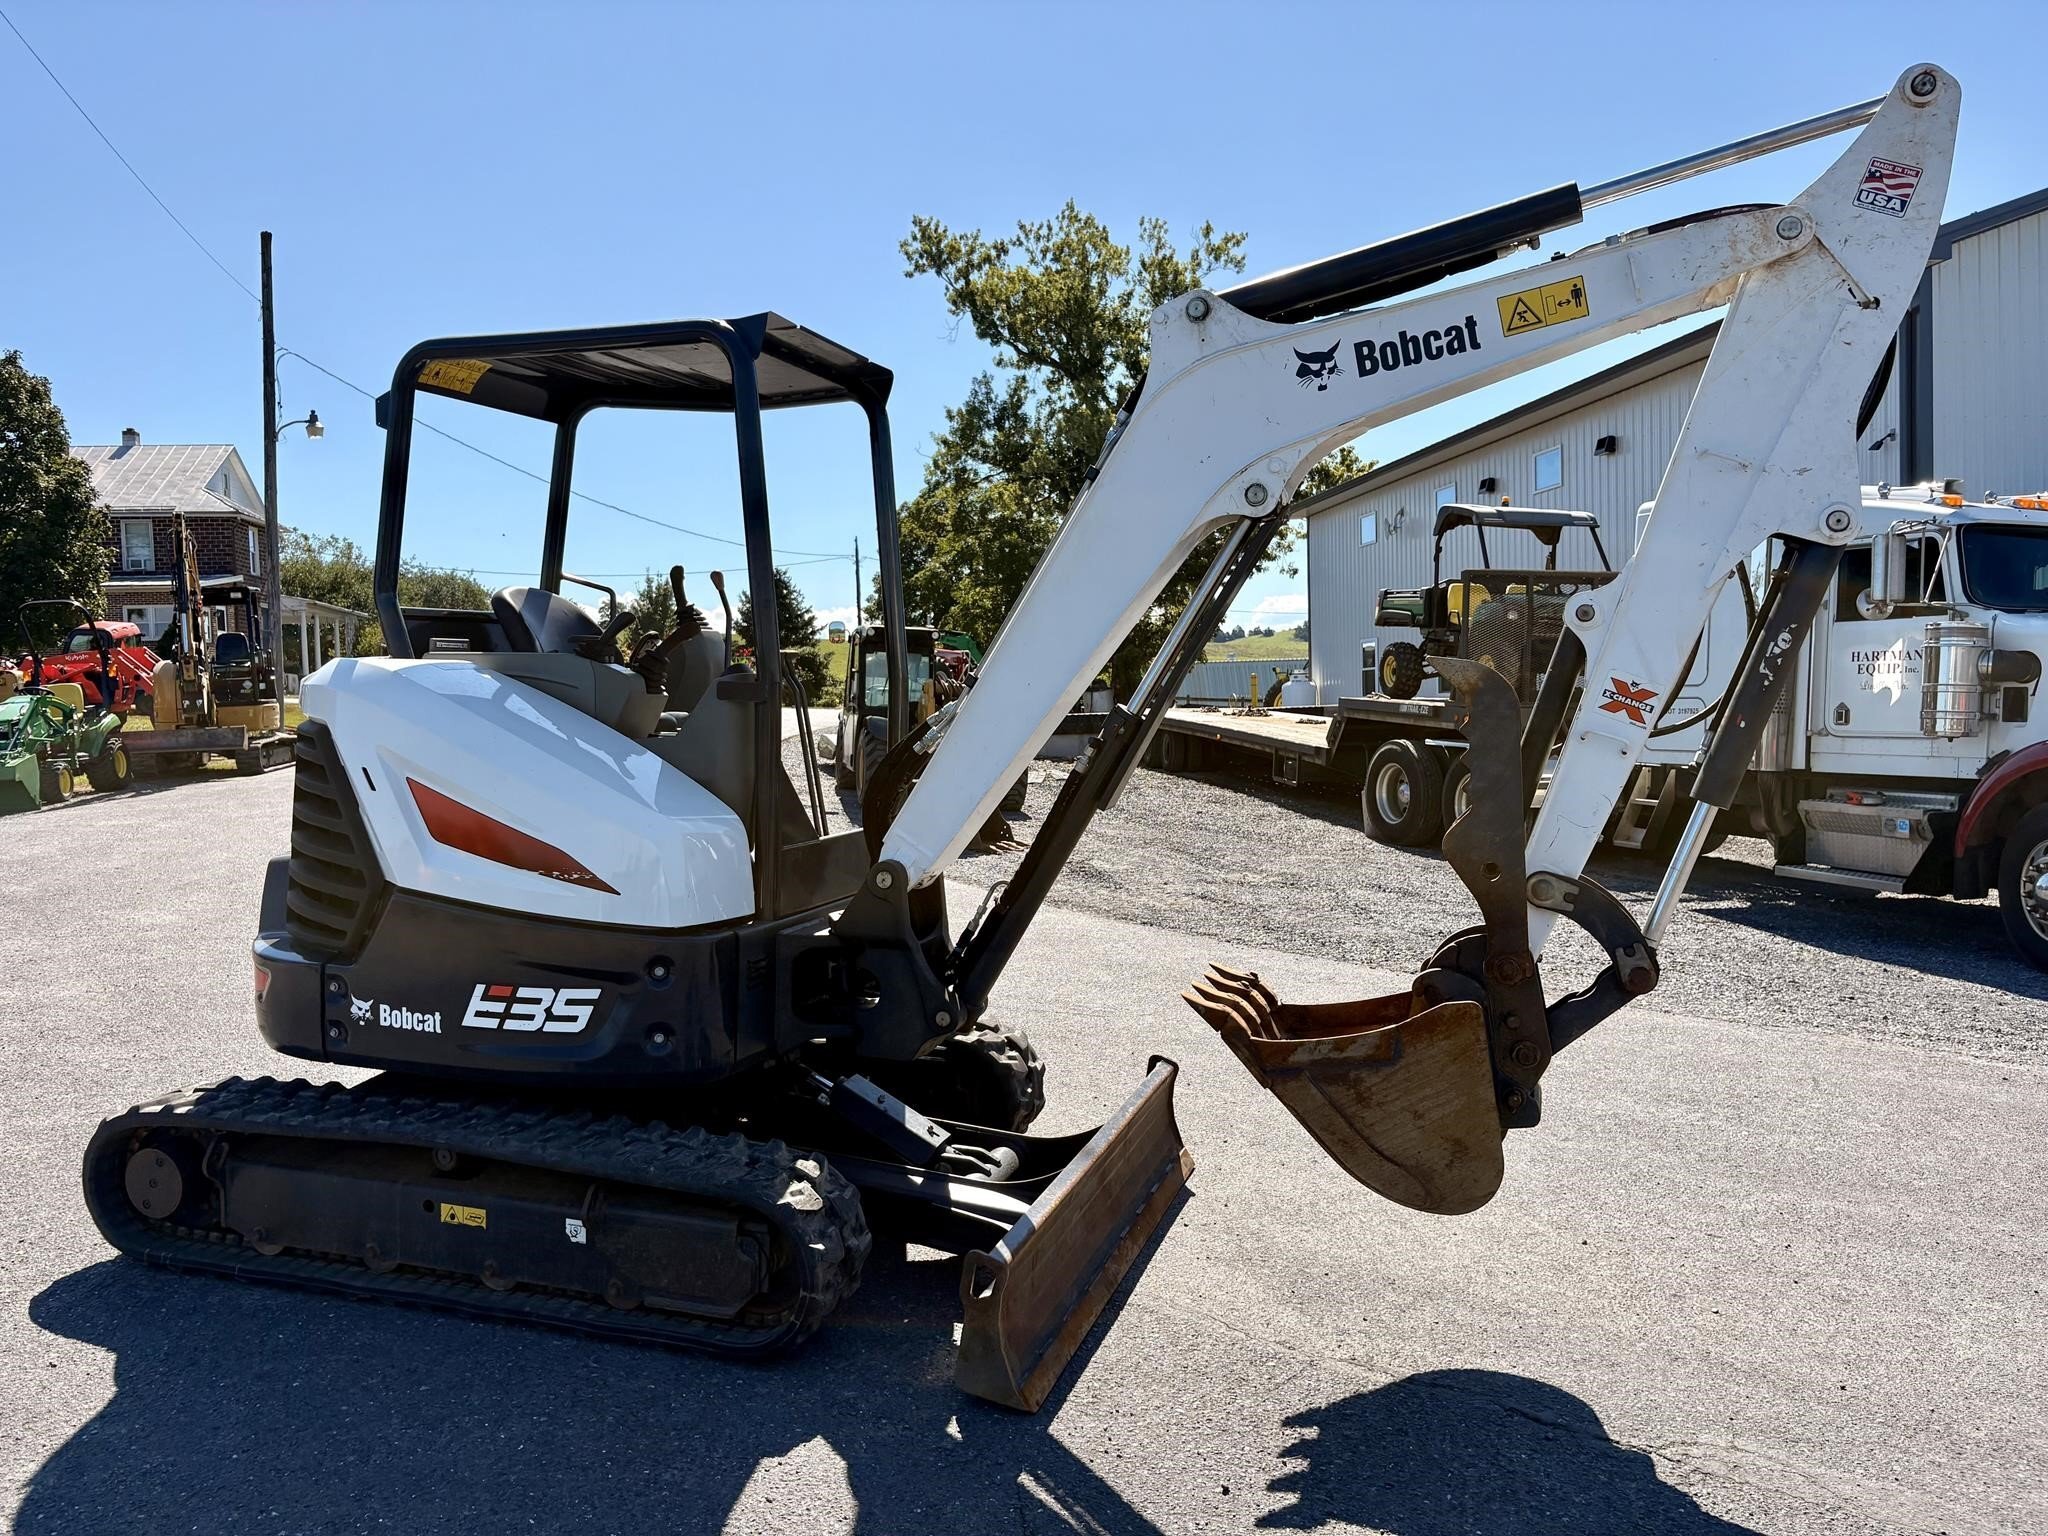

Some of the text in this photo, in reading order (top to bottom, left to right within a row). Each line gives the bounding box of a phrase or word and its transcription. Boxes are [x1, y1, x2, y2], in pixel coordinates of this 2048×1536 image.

[1873, 160, 1894, 171] MADE
[1903, 168, 1918, 176] THE
[1860, 190, 1901, 211] USA
[1353, 315, 1481, 378] Bobcat
[1851, 649, 1923, 662] HARTMAN
[379, 1003, 442, 1034] Bobcat
[461, 984, 602, 1033] E35
